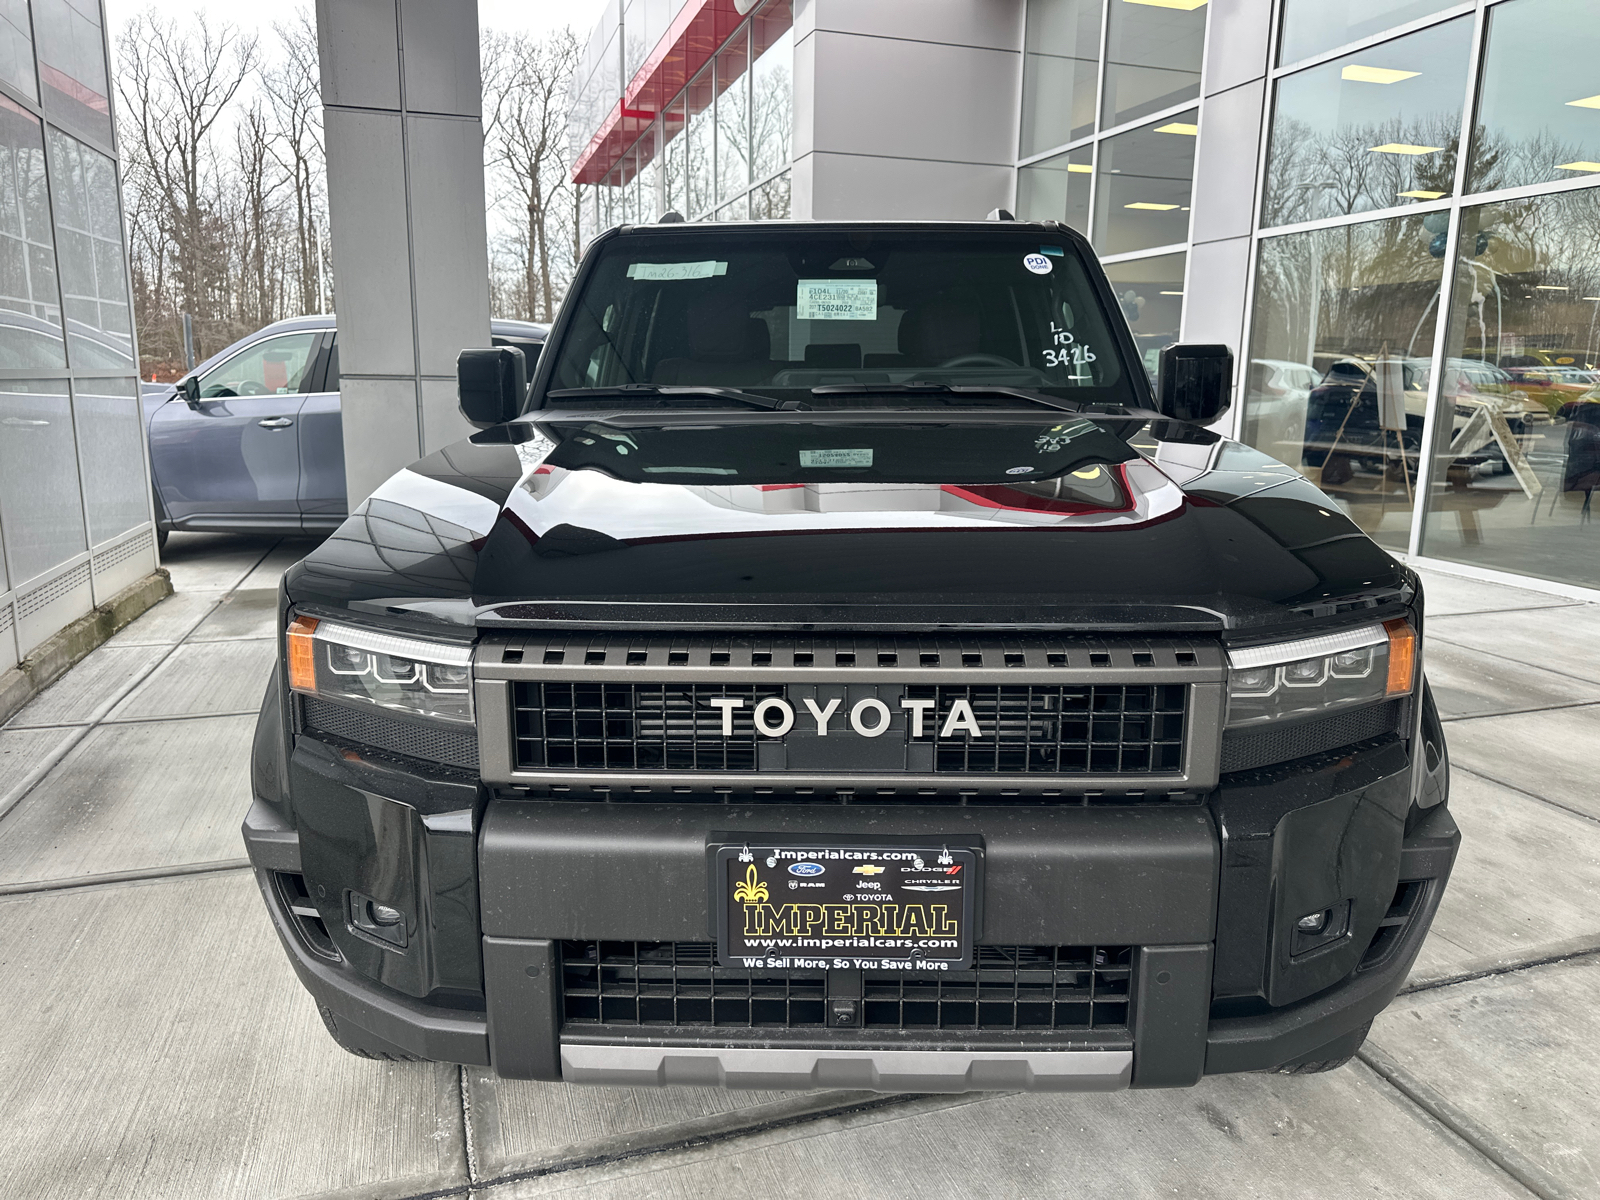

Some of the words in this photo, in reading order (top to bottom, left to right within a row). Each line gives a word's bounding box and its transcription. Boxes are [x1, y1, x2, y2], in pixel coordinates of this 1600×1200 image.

[1027, 257, 1048, 265] PDI
[817, 304, 852, 312] T5024022
[1042, 344, 1097, 367] 3426
[710, 698, 982, 738] TOYOTA
[773, 848, 918, 862] Imperialcars.com
[743, 904, 958, 937] IMPERIAL
[744, 937, 958, 949] www.imperialcars.com
[743, 958, 764, 968] We
[766, 958, 790, 968] Sell
[794, 959, 830, 970] More,
[833, 959, 850, 969] So
[853, 959, 878, 970] You
[881, 960, 912, 970] Save
[916, 960, 948, 971] More
